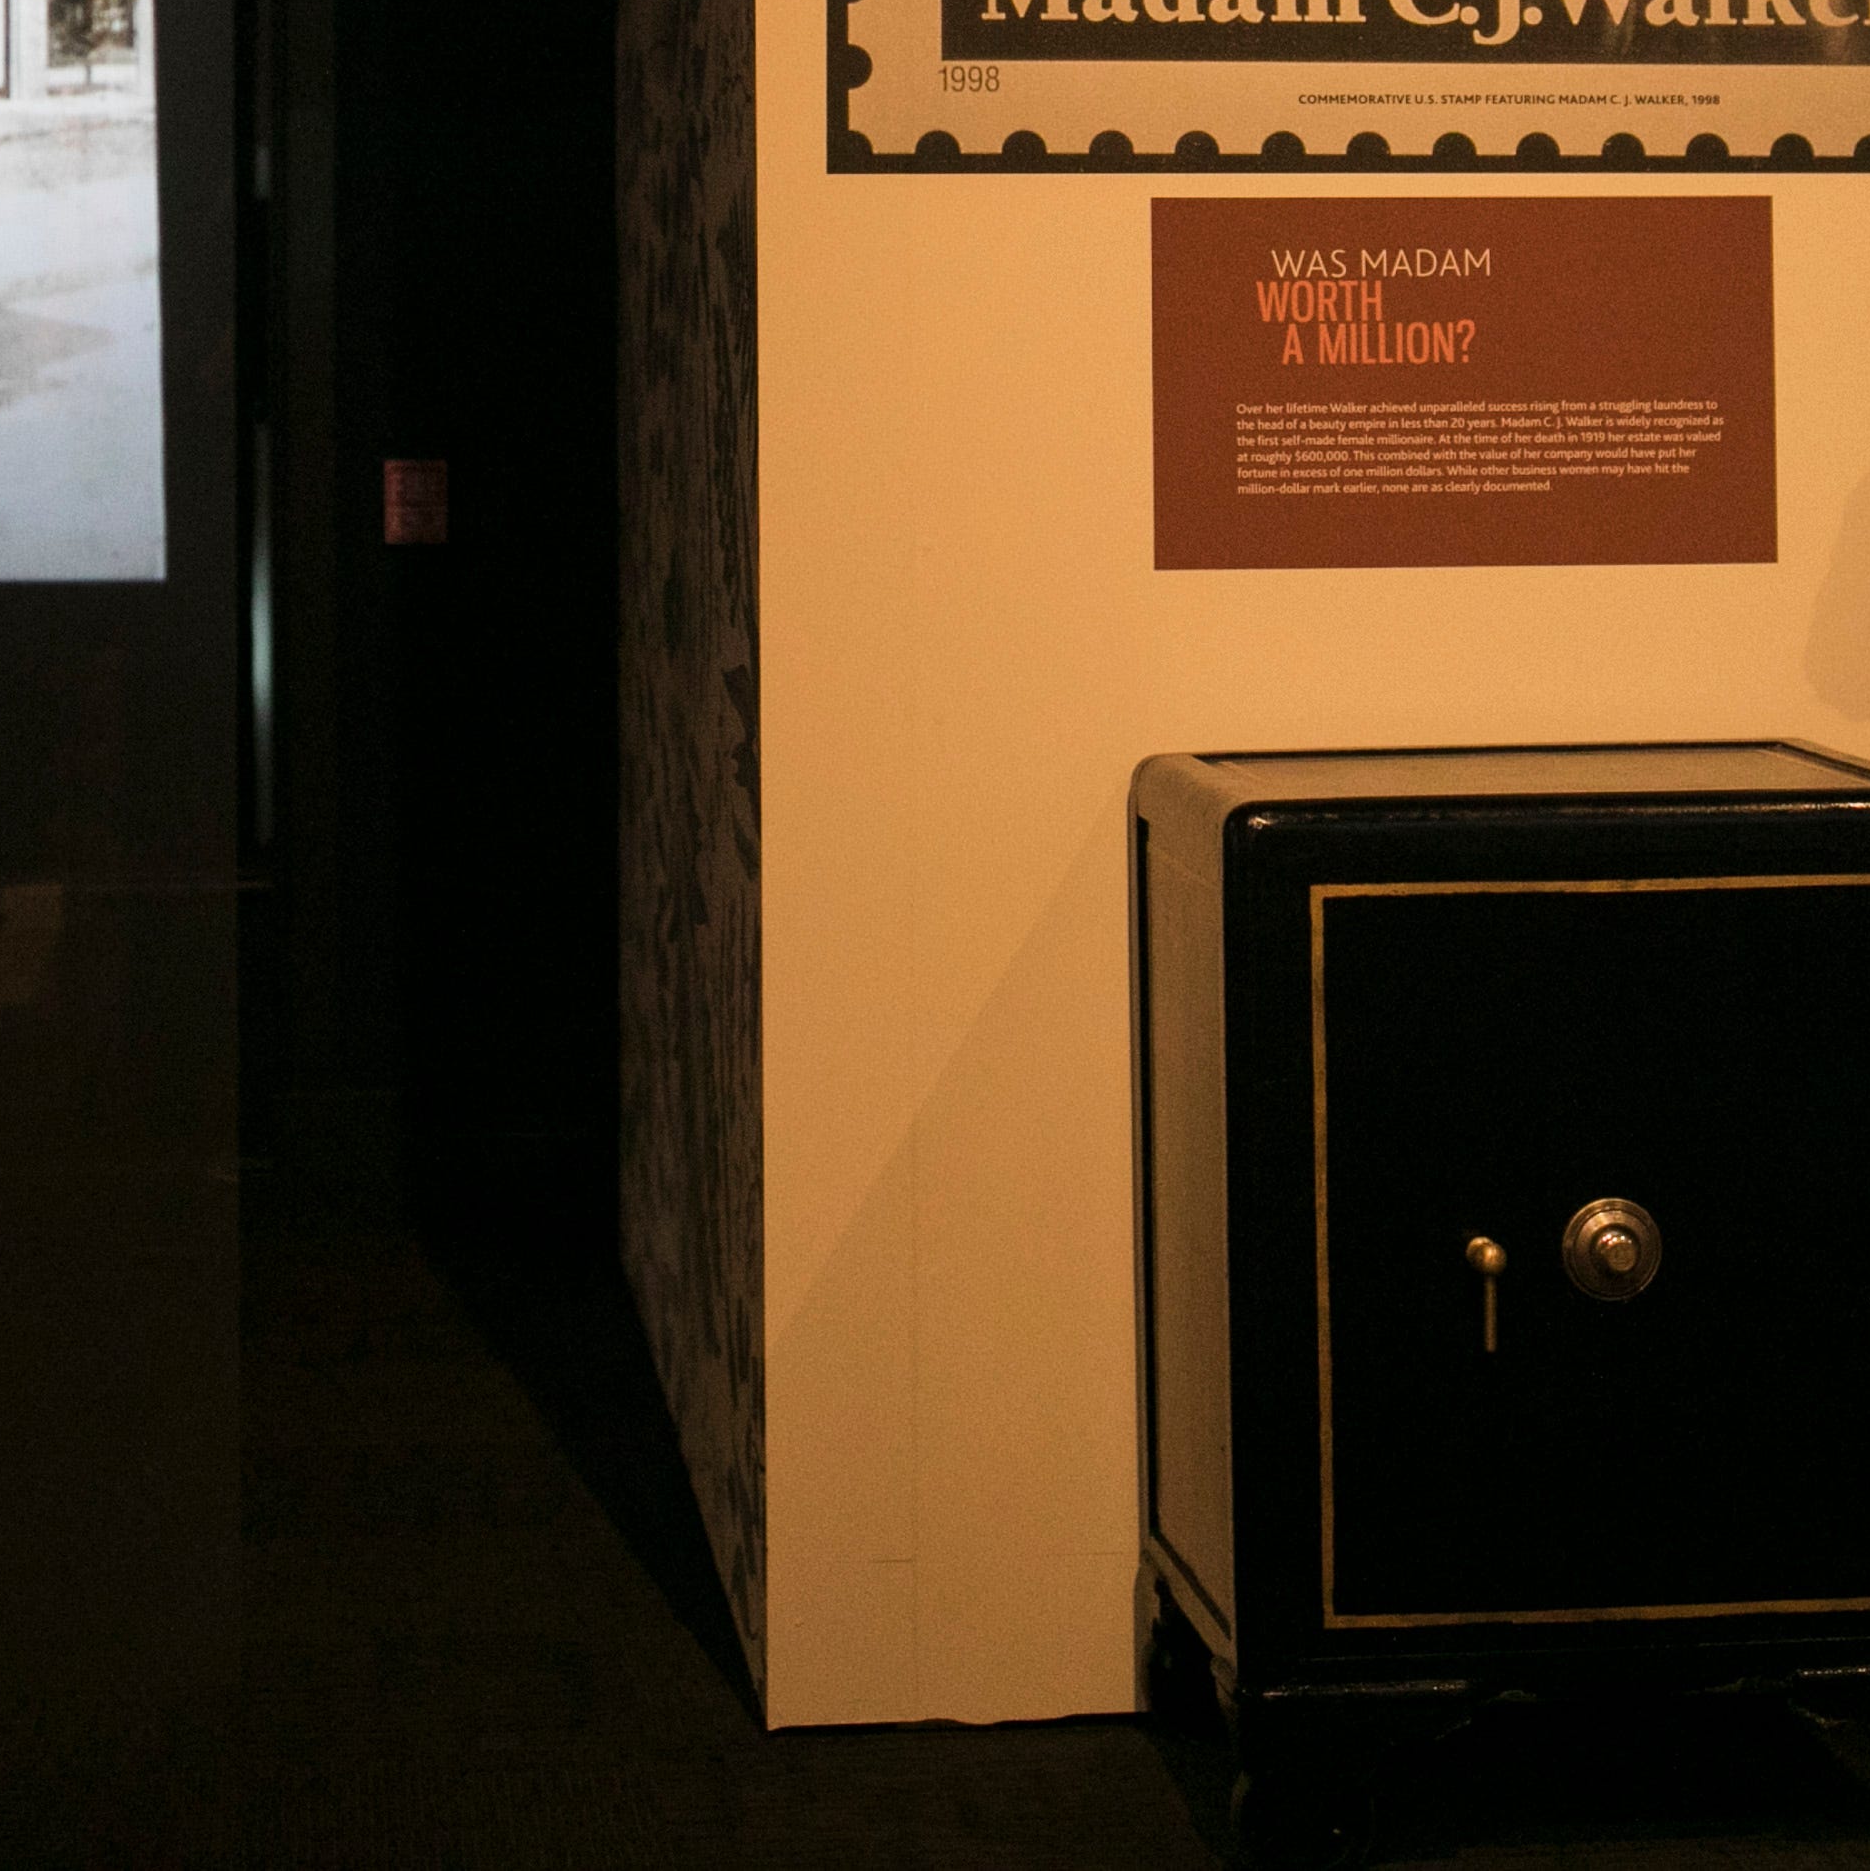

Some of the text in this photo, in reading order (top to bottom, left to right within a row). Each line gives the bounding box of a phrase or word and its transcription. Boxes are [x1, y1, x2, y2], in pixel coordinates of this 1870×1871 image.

[937, 65, 1001, 94] 1998
[1298, 93, 1412, 106] COMMEMORATIVE
[1414, 93, 1438, 106] U.S.
[1441, 93, 1483, 106] STAMP
[1485, 93, 1556, 106] FEATURING
[1558, 93, 1608, 106] MADAM
[1634, 93, 1689, 108] WALKER,
[1691, 93, 1721, 106] 1998
[1271, 247, 1492, 279] WAS MADAM
[1255, 279, 1384, 323] WORTH
[1281, 319, 1476, 365] A MILLION?
[1235, 403, 1264, 415] Over
[1265, 402, 1284, 415] her
[1285, 402, 1329, 415] lifetime
[1328, 401, 1369, 414] Walker
[1369, 401, 1418, 414] achieved
[1418, 400, 1486, 416] unparalleled
[1487, 402, 1529, 413] success
[1529, 400, 1561, 415] rising
[1560, 399, 1588, 412] from
[1597, 399, 1653, 414] struggling
[1652, 398, 1704, 411] laundress
[1235, 419, 1256, 431] the
[1256, 418, 1285, 431] head
[1308, 418, 1347, 433] beauty
[1347, 418, 1387, 432] empire
[1400, 417, 1422, 429] less
[1422, 417, 1449, 429] than
[1500, 416, 1543, 429] Madam
[1564, 415, 1604, 428] Walker
[1615, 415, 1652, 430] widely
[1652, 414, 1711, 430] recognized
[1236, 435, 1256, 447] the
[1256, 434, 1279, 447] first
[1281, 434, 1336, 447] self-made
[1336, 434, 1375, 446] female
[1452, 432, 1472, 445] the
[1472, 433, 1499, 445] time
[1513, 432, 1533, 444] her
[1533, 431, 1566, 444] death
[1580, 431, 1606, 443] 1919
[1607, 431, 1626, 443] her
[1626, 432, 1662, 443] estate
[1662, 433, 1685, 442] was
[1685, 430, 1722, 442] valued
[1250, 450, 1293, 466] roughly
[1352, 449, 1376, 461] This
[1376, 448, 1431, 462] combined
[1431, 448, 1458, 461] with
[1458, 448, 1478, 461] the
[1478, 448, 1509, 461] value
[1522, 447, 1542, 460] her
[1543, 449, 1594, 462] company
[1594, 447, 1629, 459] would
[1629, 447, 1657, 459] have
[1657, 447, 1677, 461] put
[1678, 446, 1697, 458] her
[1236, 466, 1279, 479] fortune
[1292, 468, 1328, 479] excess
[1342, 468, 1364, 478] one
[1365, 465, 1405, 478] million
[1445, 464, 1479, 476] While
[1479, 464, 1510, 476] other
[1511, 464, 1558, 476] business
[1558, 465, 1600, 476] women
[1600, 465, 1626, 478] may
[1626, 462, 1653, 475] have
[1653, 462, 1670, 474] hit
[1670, 462, 1691, 474] the
[1236, 482, 1311, 495] million-dollar
[1312, 481, 1341, 494] mark
[1381, 483, 1410, 494] none
[1410, 483, 1430, 493] are
[1444, 479, 1482, 495] clearly
